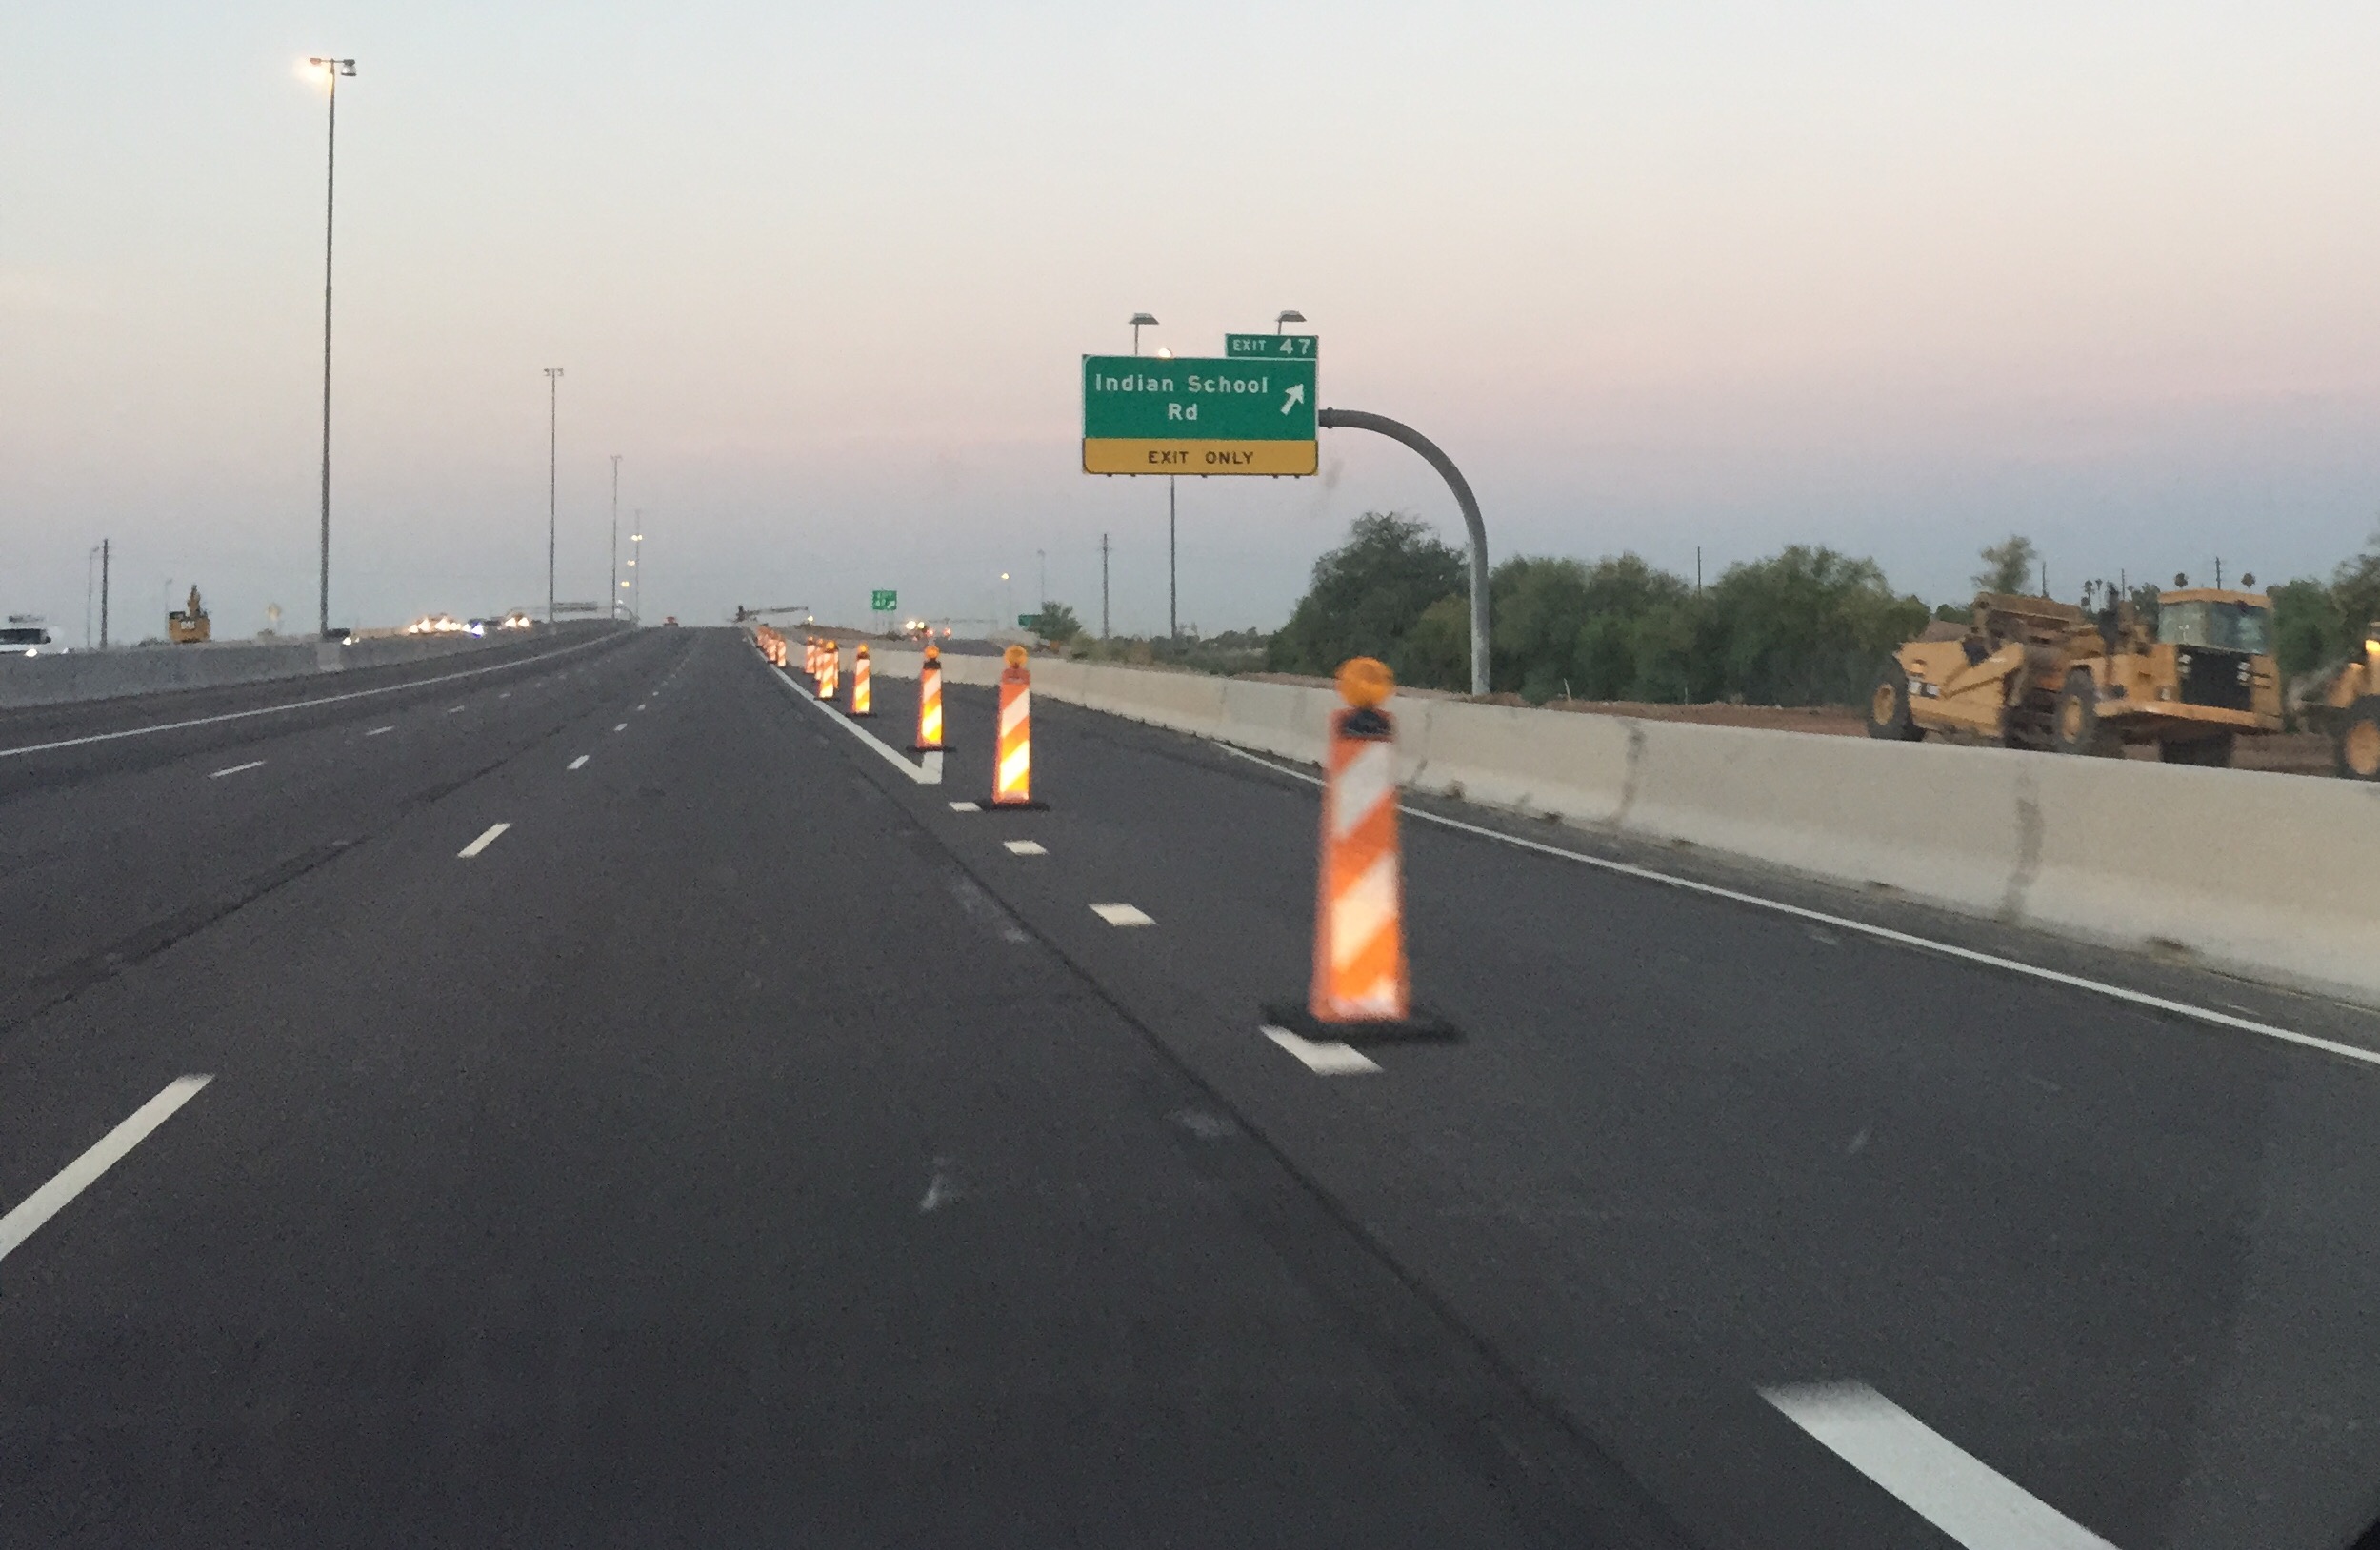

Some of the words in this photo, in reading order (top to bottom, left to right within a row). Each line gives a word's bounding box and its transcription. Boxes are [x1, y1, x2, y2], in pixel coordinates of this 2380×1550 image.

[1233, 339, 1266, 351] EXIT
[1279, 338, 1310, 354] 47
[1096, 374, 1174, 392] Indian
[1188, 376, 1268, 393] School
[1168, 403, 1198, 420] Rd
[1149, 451, 1189, 464] EXIT
[1206, 451, 1253, 464] ONLY
